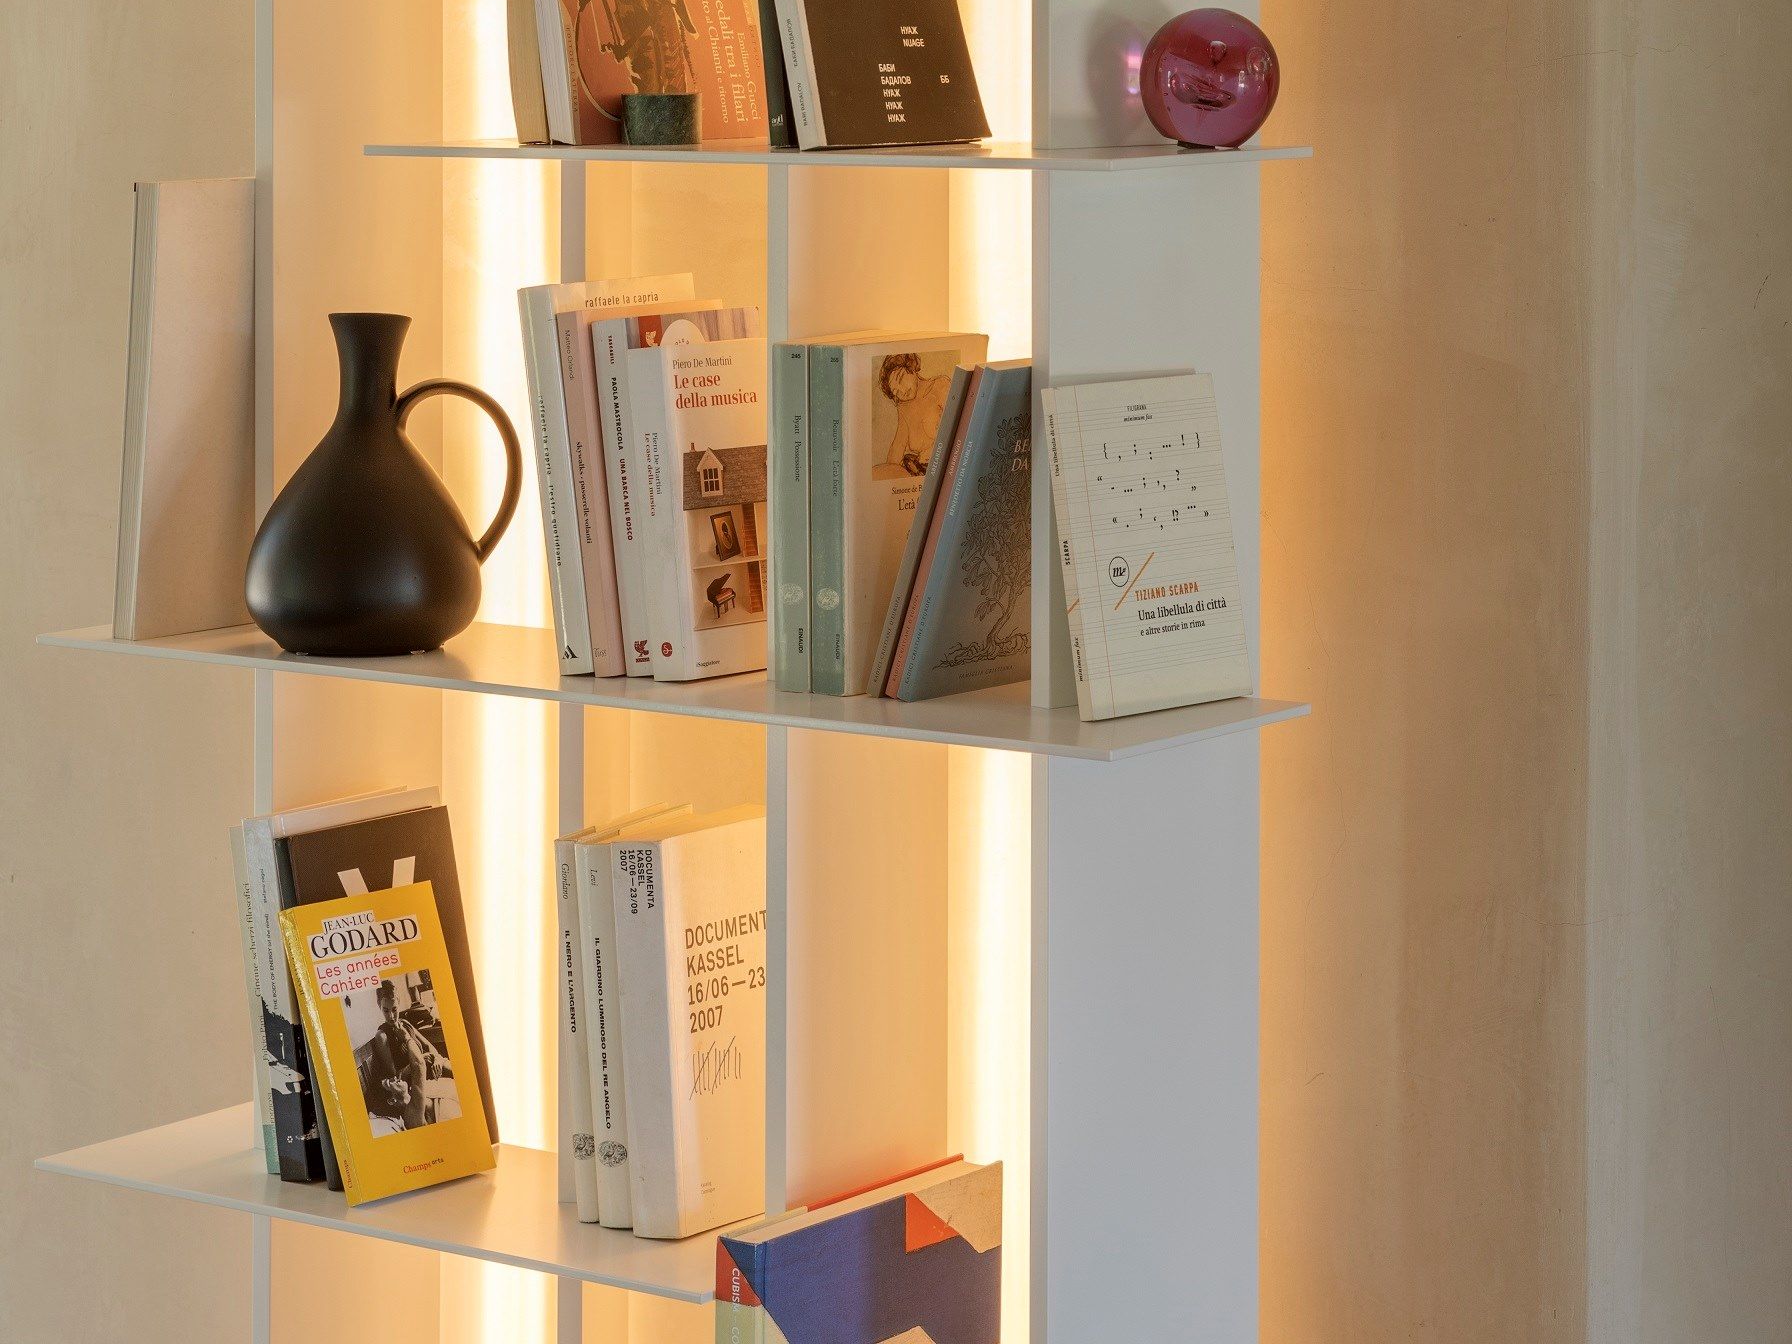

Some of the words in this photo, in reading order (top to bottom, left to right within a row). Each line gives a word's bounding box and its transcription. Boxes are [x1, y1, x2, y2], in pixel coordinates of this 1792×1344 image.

[903, 39, 925, 47] NUAGE
[708, 27, 725, 75] Chianti
[718, 86, 728, 124] ritorno
[737, 32, 750, 79] Emiliano
[747, 80, 761, 121] Gucci
[879, 64, 895, 72] БАБИ
[724, 44, 736, 69] tra
[732, 82, 748, 123] filari
[881, 76, 911, 86] БАДАЛОВ
[883, 89, 901, 97] НУАЖ
[886, 101, 903, 110] НУАЖ
[888, 114, 906, 122] НУАЖ
[585, 295, 620, 308] raffaele
[623, 294, 630, 304] la
[634, 292, 659, 304] capria
[672, 358, 692, 370] Piero
[693, 358, 703, 368] De
[705, 356, 732, 367] Martini
[674, 374, 689, 390] Le
[692, 374, 720, 388] case
[675, 391, 707, 410] della
[711, 388, 758, 407] musica
[613, 401, 623, 451] MASTROCOLA
[793, 415, 801, 434] Byatt
[576, 441, 584, 476] skywalks
[1011, 458, 1029, 472] DA
[579, 480, 589, 517] passerelle
[898, 498, 915, 511] L'età
[584, 518, 592, 544] volanti
[1063, 540, 1071, 565] SCARPA
[1135, 586, 1166, 601] TIZIANO
[1170, 582, 1200, 596] SCARPA
[1138, 610, 1156, 621] Una
[1157, 602, 1194, 617] libellula
[1196, 601, 1205, 612] di
[1207, 597, 1226, 610] città
[1146, 627, 1160, 635] altre
[1162, 623, 1180, 633] storie
[1181, 621, 1188, 629] in
[1190, 620, 1205, 628] rima
[590, 868, 599, 888] Levi
[637, 849, 645, 887] KASSEL
[644, 849, 654, 909] DOCUMENTA
[561, 863, 569, 900] Giordano
[323, 912, 374, 935] JEAN-LUC
[311, 918, 418, 959] GODARD
[317, 966, 341, 979] Les
[347, 954, 399, 973] années
[595, 949, 603, 996] GIARDINO
[687, 944, 744, 977] KASSEL
[321, 976, 379, 996] Cahiers
[568, 979, 576, 1033] L'ARGENTO
[598, 999, 606, 1049] LUMINOSO
[690, 1005, 722, 1034] 2007
[603, 1089, 611, 1129] ANGELO
[403, 1162, 431, 1174] Champs
[432, 1157, 444, 1165] arts
